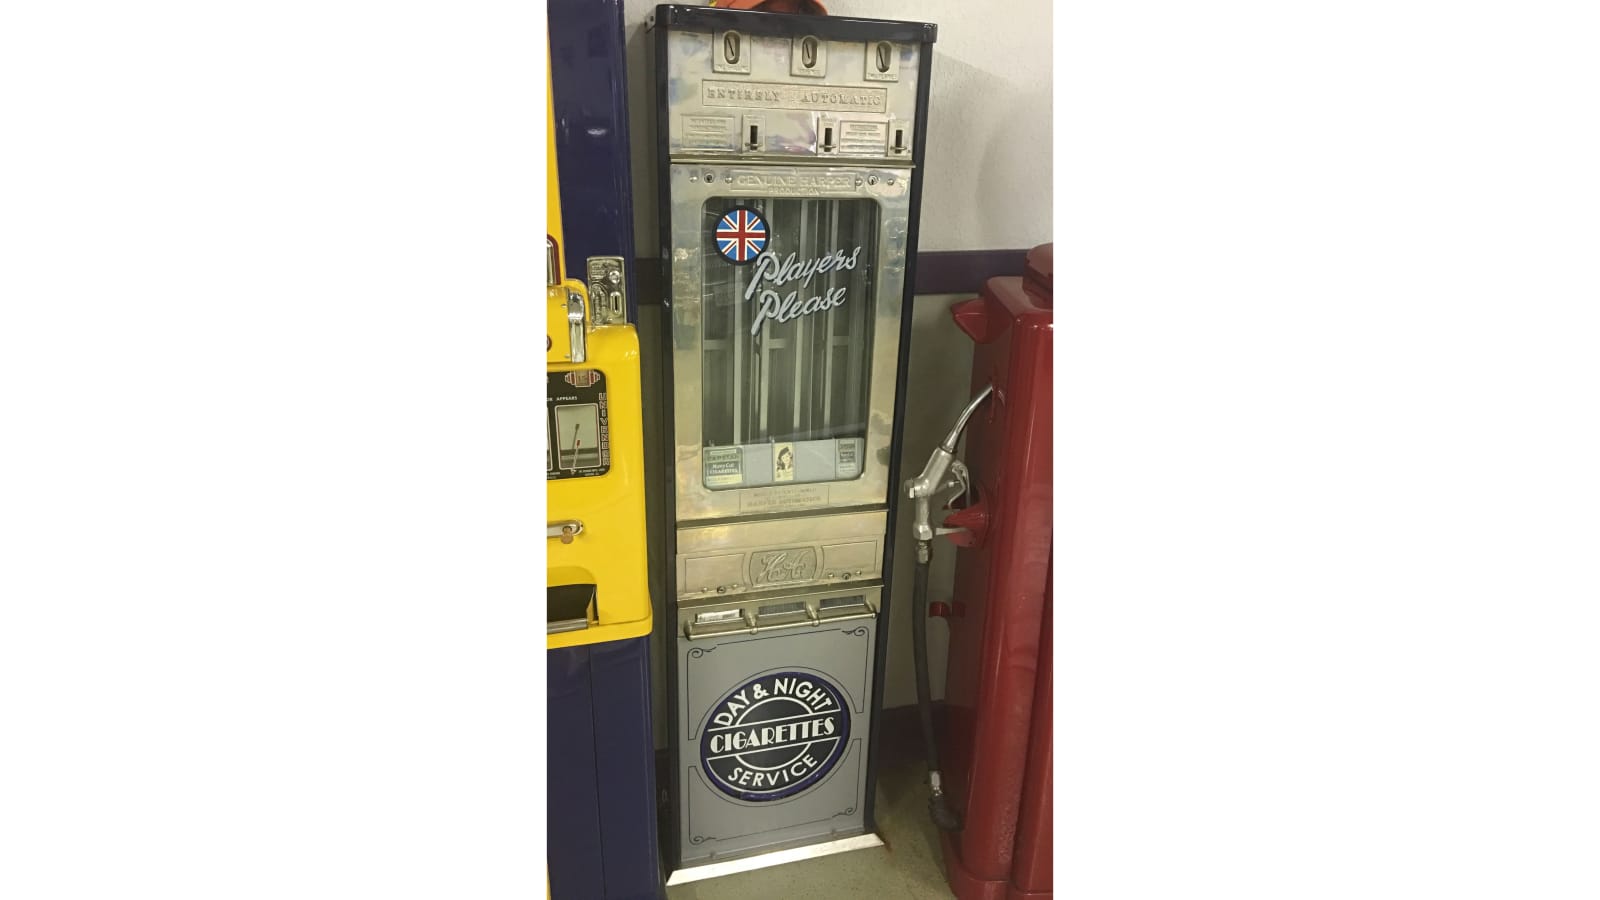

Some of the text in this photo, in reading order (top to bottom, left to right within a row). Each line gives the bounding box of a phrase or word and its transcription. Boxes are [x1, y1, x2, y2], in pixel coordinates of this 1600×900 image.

[706, 87, 882, 106] ENTIRELY AUTOMATIC
[736, 174, 797, 187] GENUINE
[745, 246, 861, 300] Players
[751, 287, 847, 336] Please
[713, 678, 833, 727] DAY & NIGHT
[710, 717, 835, 754] CIGARETTES
[727, 753, 818, 787] SERVICE
